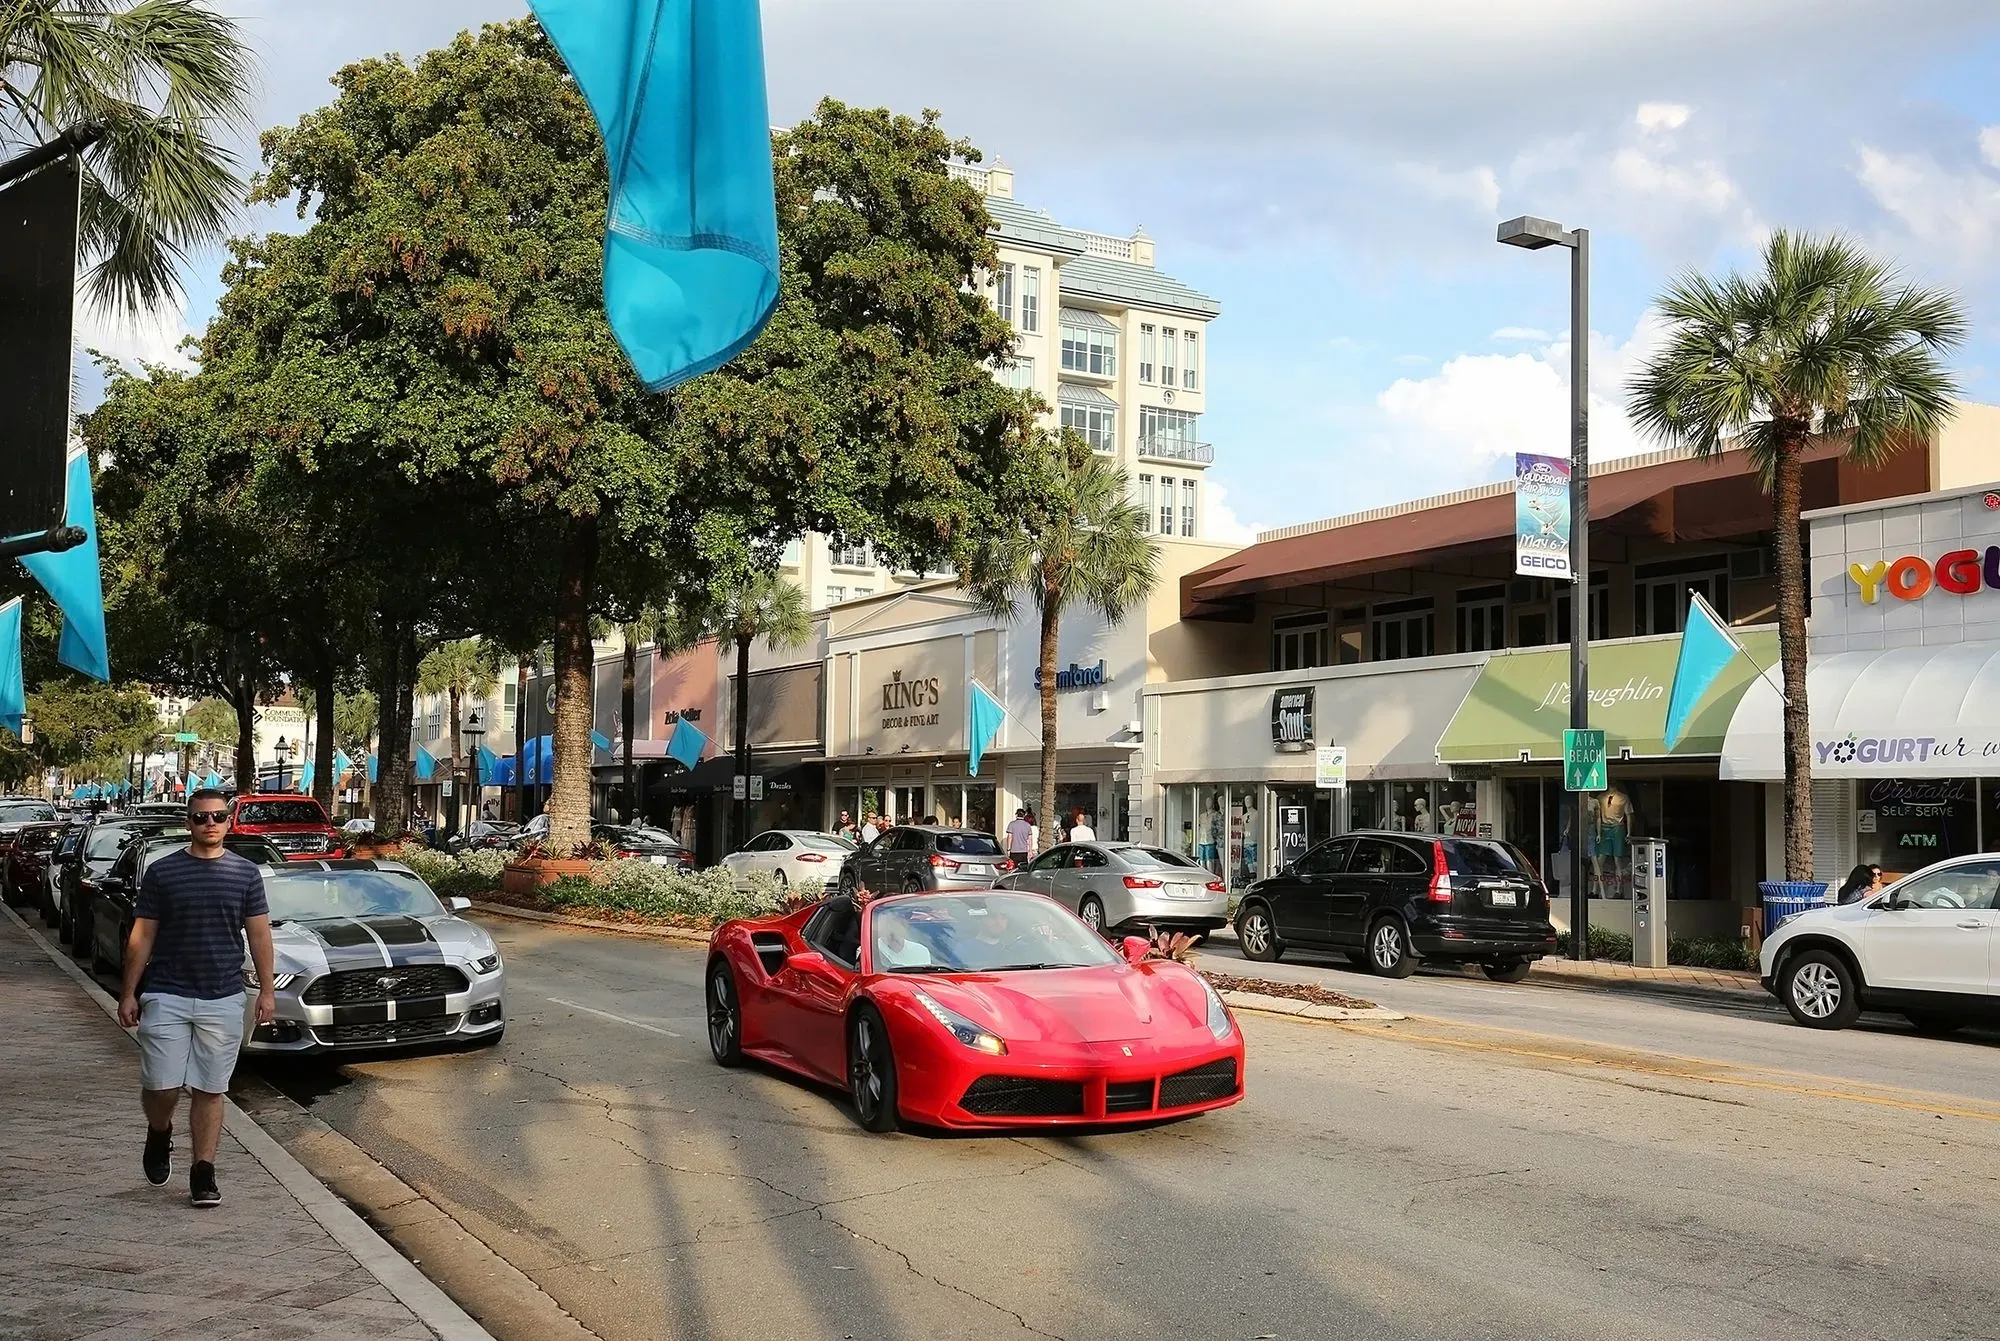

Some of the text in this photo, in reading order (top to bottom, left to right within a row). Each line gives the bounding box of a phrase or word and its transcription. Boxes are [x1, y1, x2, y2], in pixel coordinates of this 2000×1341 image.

[1521, 555, 1567, 570] GEICO
[882, 677, 939, 710] KING'S
[903, 716, 909, 727] &
[910, 714, 926, 727] FINE
[926, 713, 939, 726] ART
[1280, 708, 1305, 741] Soul
[1576, 733, 1596, 746] A1A
[1570, 749, 1602, 763] BEACH
[1881, 805, 1955, 818] SELF SERVE
[1283, 832, 1307, 848] 70%
[1900, 833, 1937, 847] ATM
[1655, 850, 1663, 861] P
